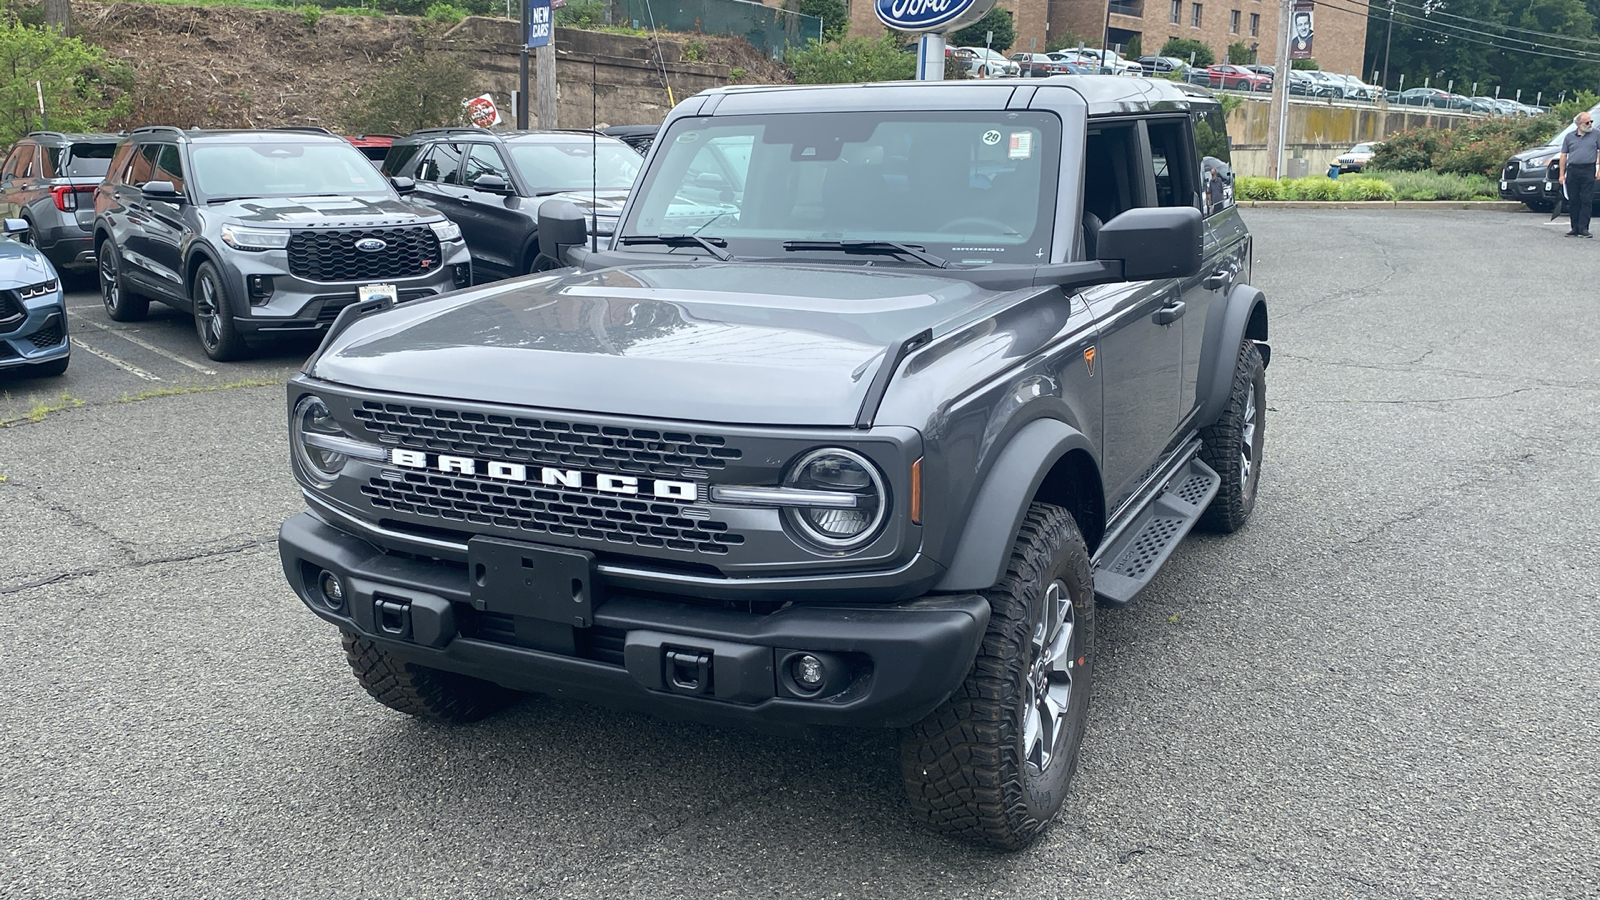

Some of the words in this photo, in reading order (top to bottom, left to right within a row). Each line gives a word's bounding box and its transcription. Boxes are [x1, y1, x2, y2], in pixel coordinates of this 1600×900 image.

[533, 6, 549, 23] NEW
[532, 23, 549, 38] CARS
[984, 131, 1000, 142] 29
[392, 448, 697, 501] BRONCO
